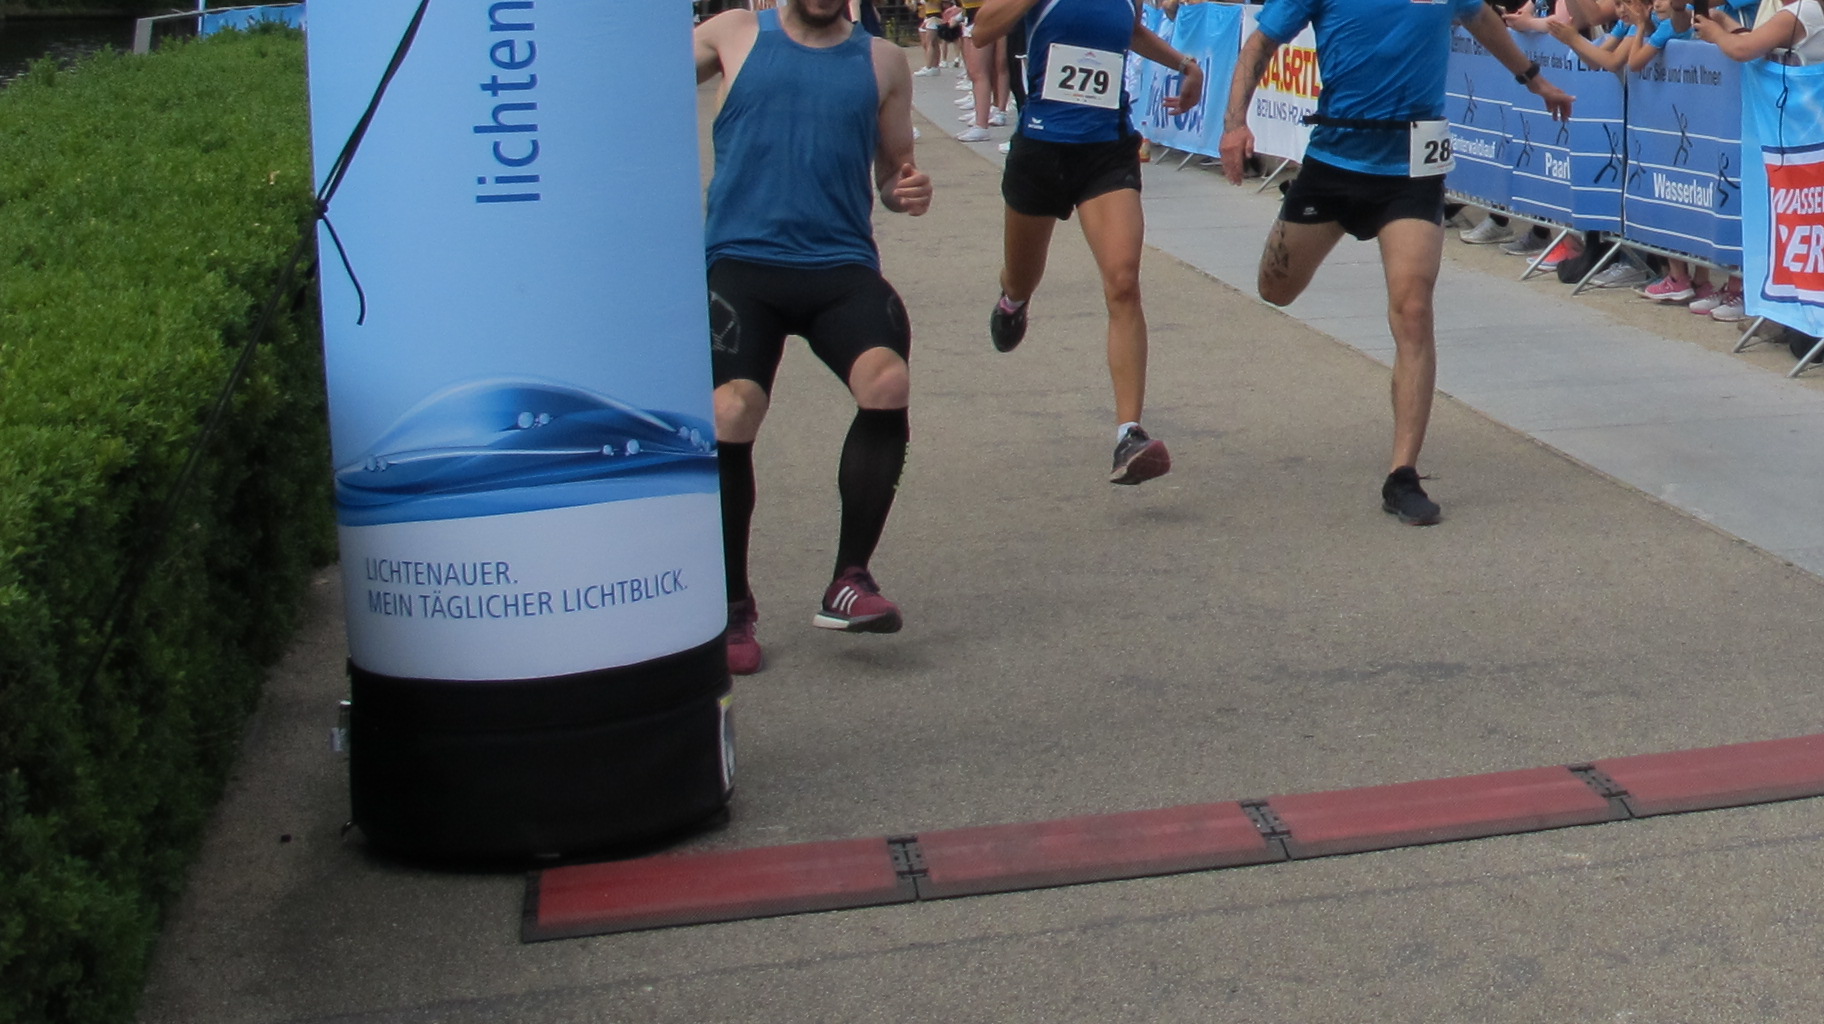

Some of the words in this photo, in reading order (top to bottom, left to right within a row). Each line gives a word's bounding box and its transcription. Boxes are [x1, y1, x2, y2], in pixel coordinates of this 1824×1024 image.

[1058, 65, 1110, 95] 279
[1423, 138, 1452, 164] 28
[1653, 172, 1714, 208] Wasserlauf
[366, 557, 519, 587] LICHTENAUER.
[368, 589, 412, 617] MEIN
[418, 589, 554, 620] TÄGLICHER
[562, 568, 689, 614] LICHTBLICK.
